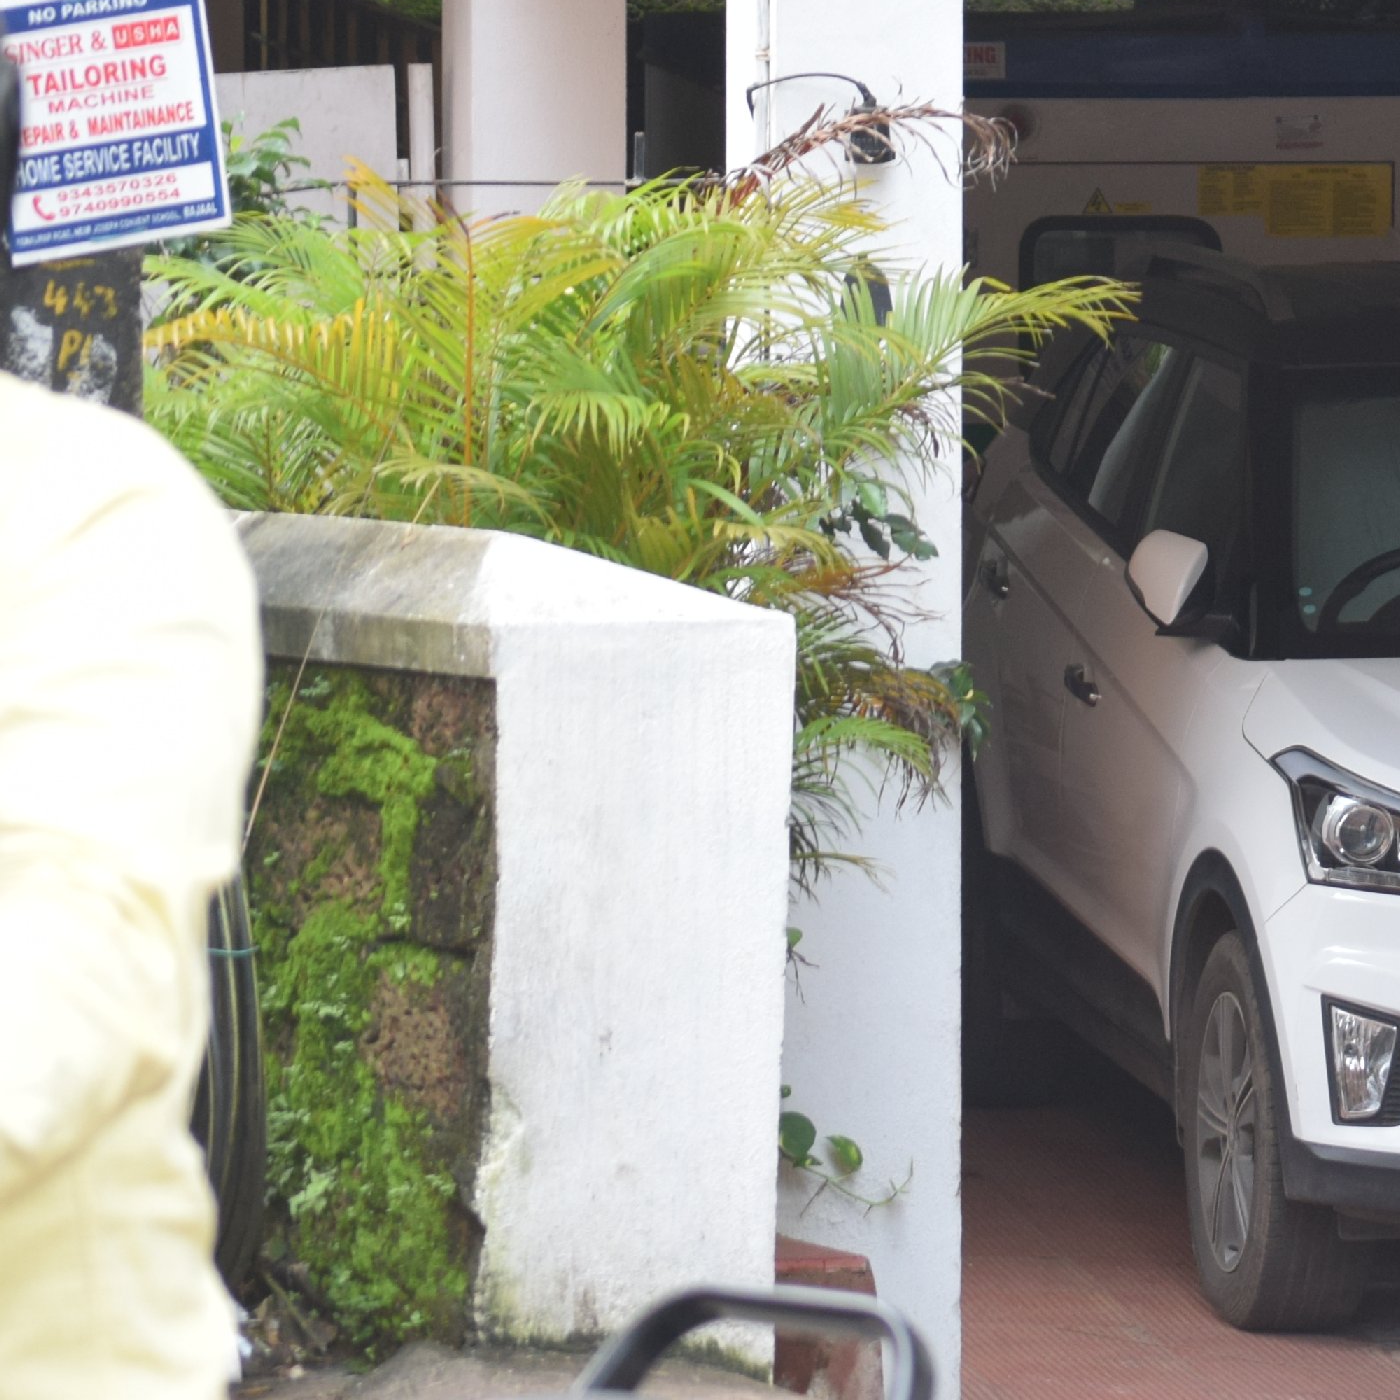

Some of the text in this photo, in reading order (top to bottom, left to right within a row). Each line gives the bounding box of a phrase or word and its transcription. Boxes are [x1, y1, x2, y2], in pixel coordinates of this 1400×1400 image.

[28, 7, 56, 26] NO
[4, 20, 179, 66] SINGER & USHA
[26, 55, 167, 97] TAILORING
[48, 84, 155, 115] MACHINE
[20, 123, 65, 148] EPAIR
[88, 101, 195, 137] MAINTAINANCE
[63, 143, 131, 180] SERVICE
[133, 133, 200, 168] FACILITY
